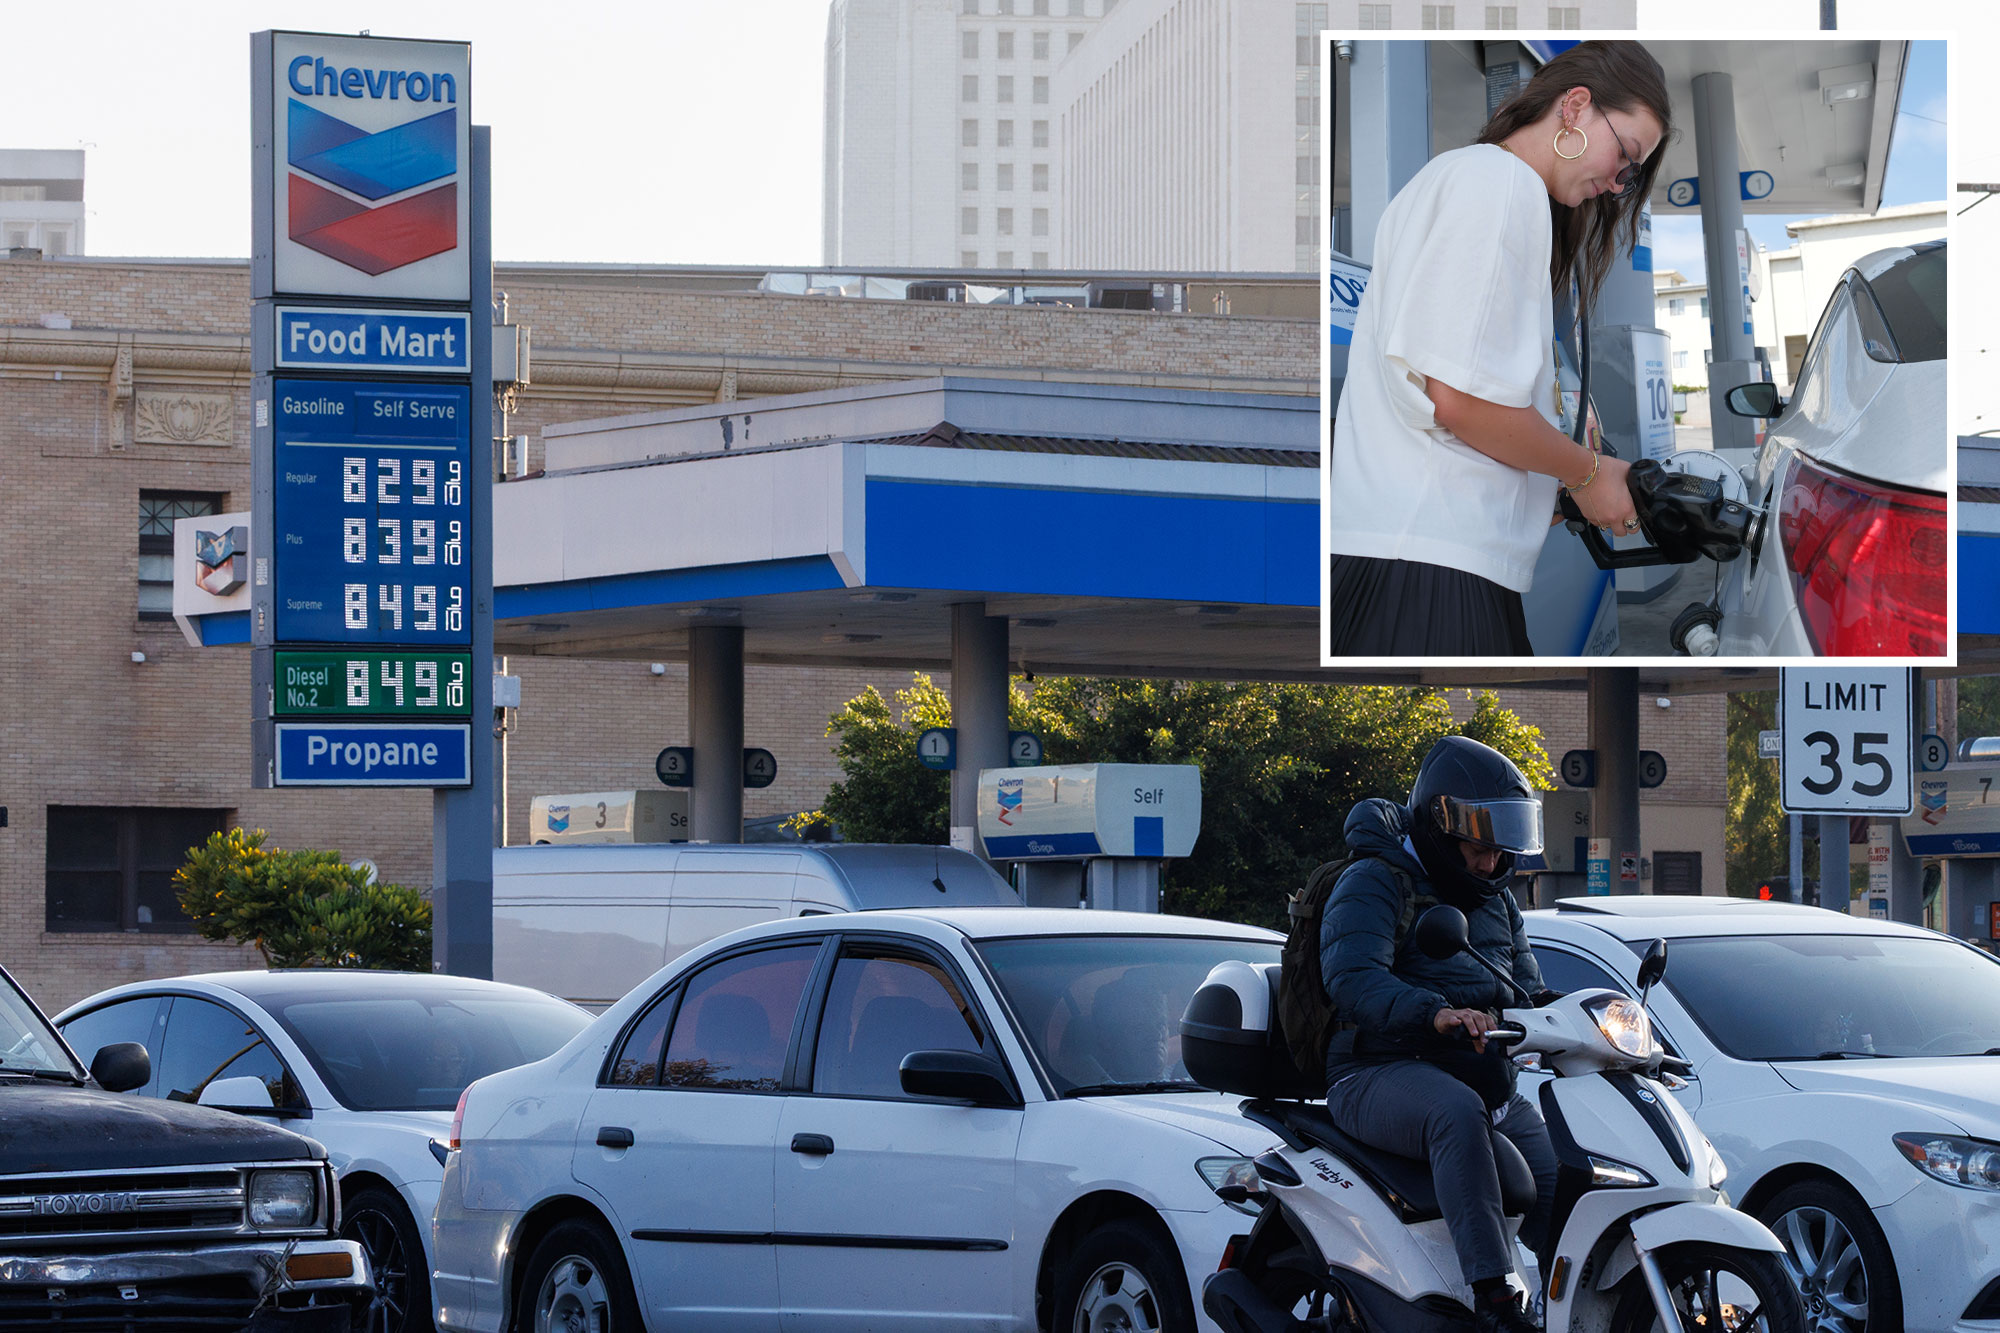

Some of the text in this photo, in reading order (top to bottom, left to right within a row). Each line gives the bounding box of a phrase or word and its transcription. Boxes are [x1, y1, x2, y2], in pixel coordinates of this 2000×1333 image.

[288, 55, 457, 103] Chevron
[1756, 178, 1762, 191] 1
[1676, 187, 1688, 200] 2
[290, 321, 456, 358] Food Mart
[283, 397, 344, 415] Gasoline
[373, 400, 403, 417] Self
[409, 402, 455, 419] Serve
[286, 472, 317, 485] Regular
[343, 457, 436, 505] 829
[286, 533, 303, 545] Plus
[343, 518, 436, 565] 839
[287, 599, 323, 610] Supreme
[344, 583, 437, 631] 849
[287, 667, 328, 686] Diesel
[346, 660, 438, 707] 849
[287, 689, 318, 707] No.2
[1804, 681, 1887, 712] LIMIT
[307, 735, 439, 772] Propane
[931, 738, 937, 753] 1
[1020, 742, 1031, 756] 2
[1928, 746, 1939, 763] 8
[668, 756, 678, 771] 3
[754, 758, 765, 773] 4
[1570, 760, 1581, 777] 5
[1646, 762, 1657, 778] 6
[1801, 730, 1893, 797] 35
[998, 778, 1024, 787] Chevron
[1921, 780, 1948, 789] Chevron
[1979, 777, 1992, 804] 7
[1133, 788, 1164, 804] Self
[595, 801, 606, 828] 3
[670, 812, 688, 827] Se
[1575, 811, 1589, 825] Se
[34, 1193, 138, 1216] TOYOTA
